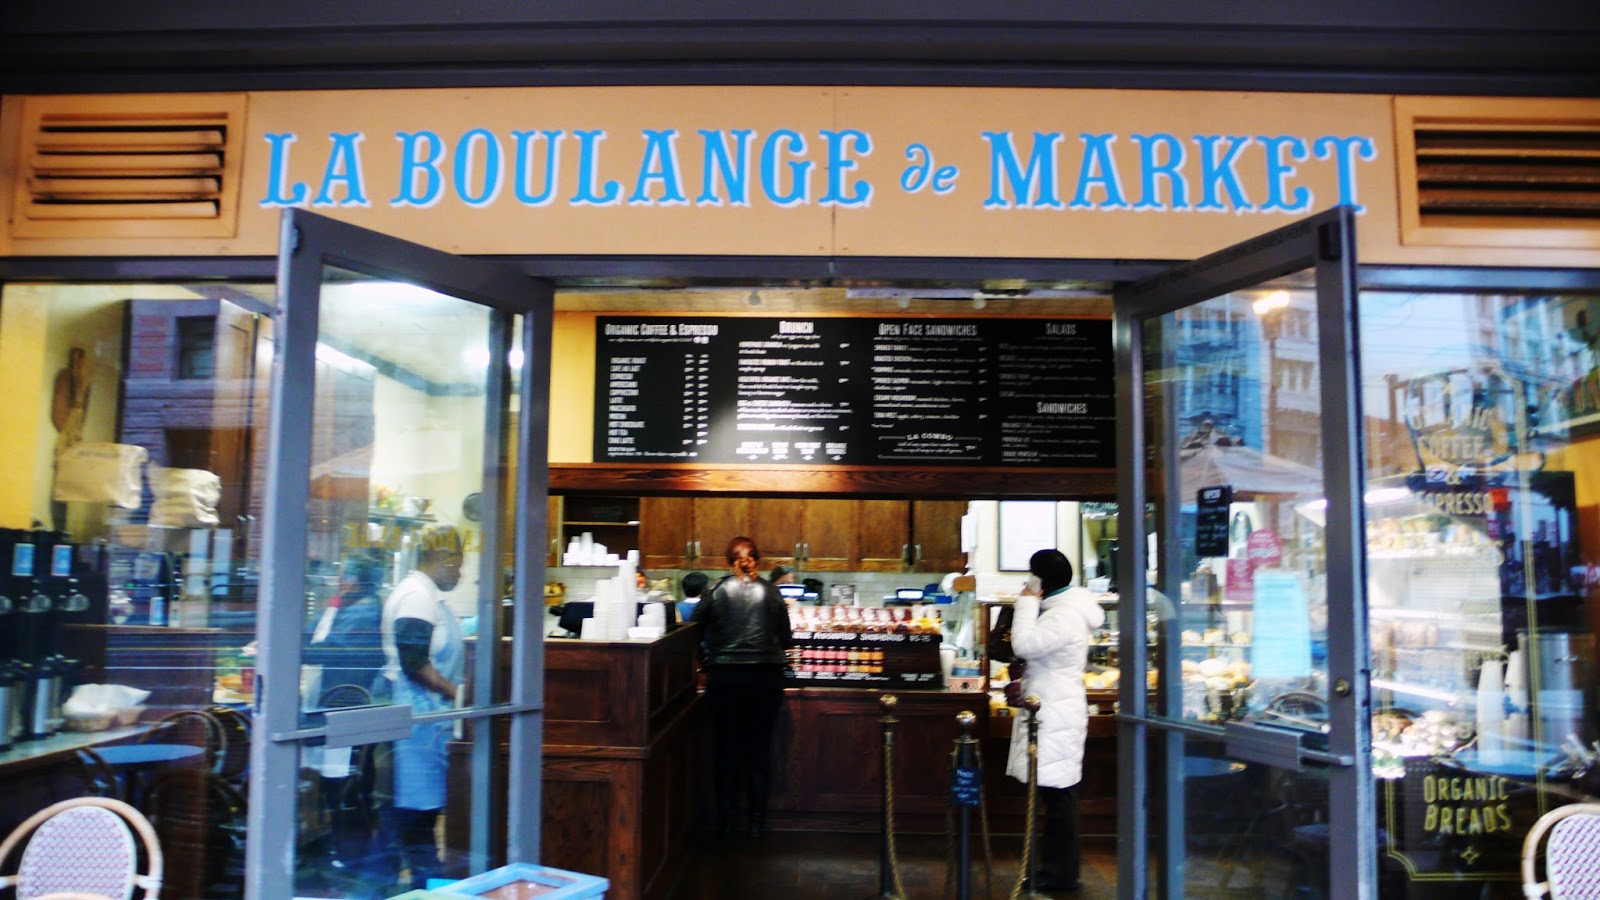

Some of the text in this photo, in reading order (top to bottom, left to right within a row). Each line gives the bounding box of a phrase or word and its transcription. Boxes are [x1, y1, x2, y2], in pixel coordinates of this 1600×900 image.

[259, 128, 1378, 215] LA BOULANGE de MARKET
[604, 323, 719, 336] ORGANIC COFFEE & ESPRESSO
[778, 320, 814, 334] BRUNCH
[878, 323, 979, 336] OPEN FACE SANDWICHES
[1045, 322, 1078, 336] SALADS
[1036, 401, 1088, 414] SANDWICHES
[1423, 774, 1510, 804] ORGANIC
[1423, 804, 1512, 835] BREADS
